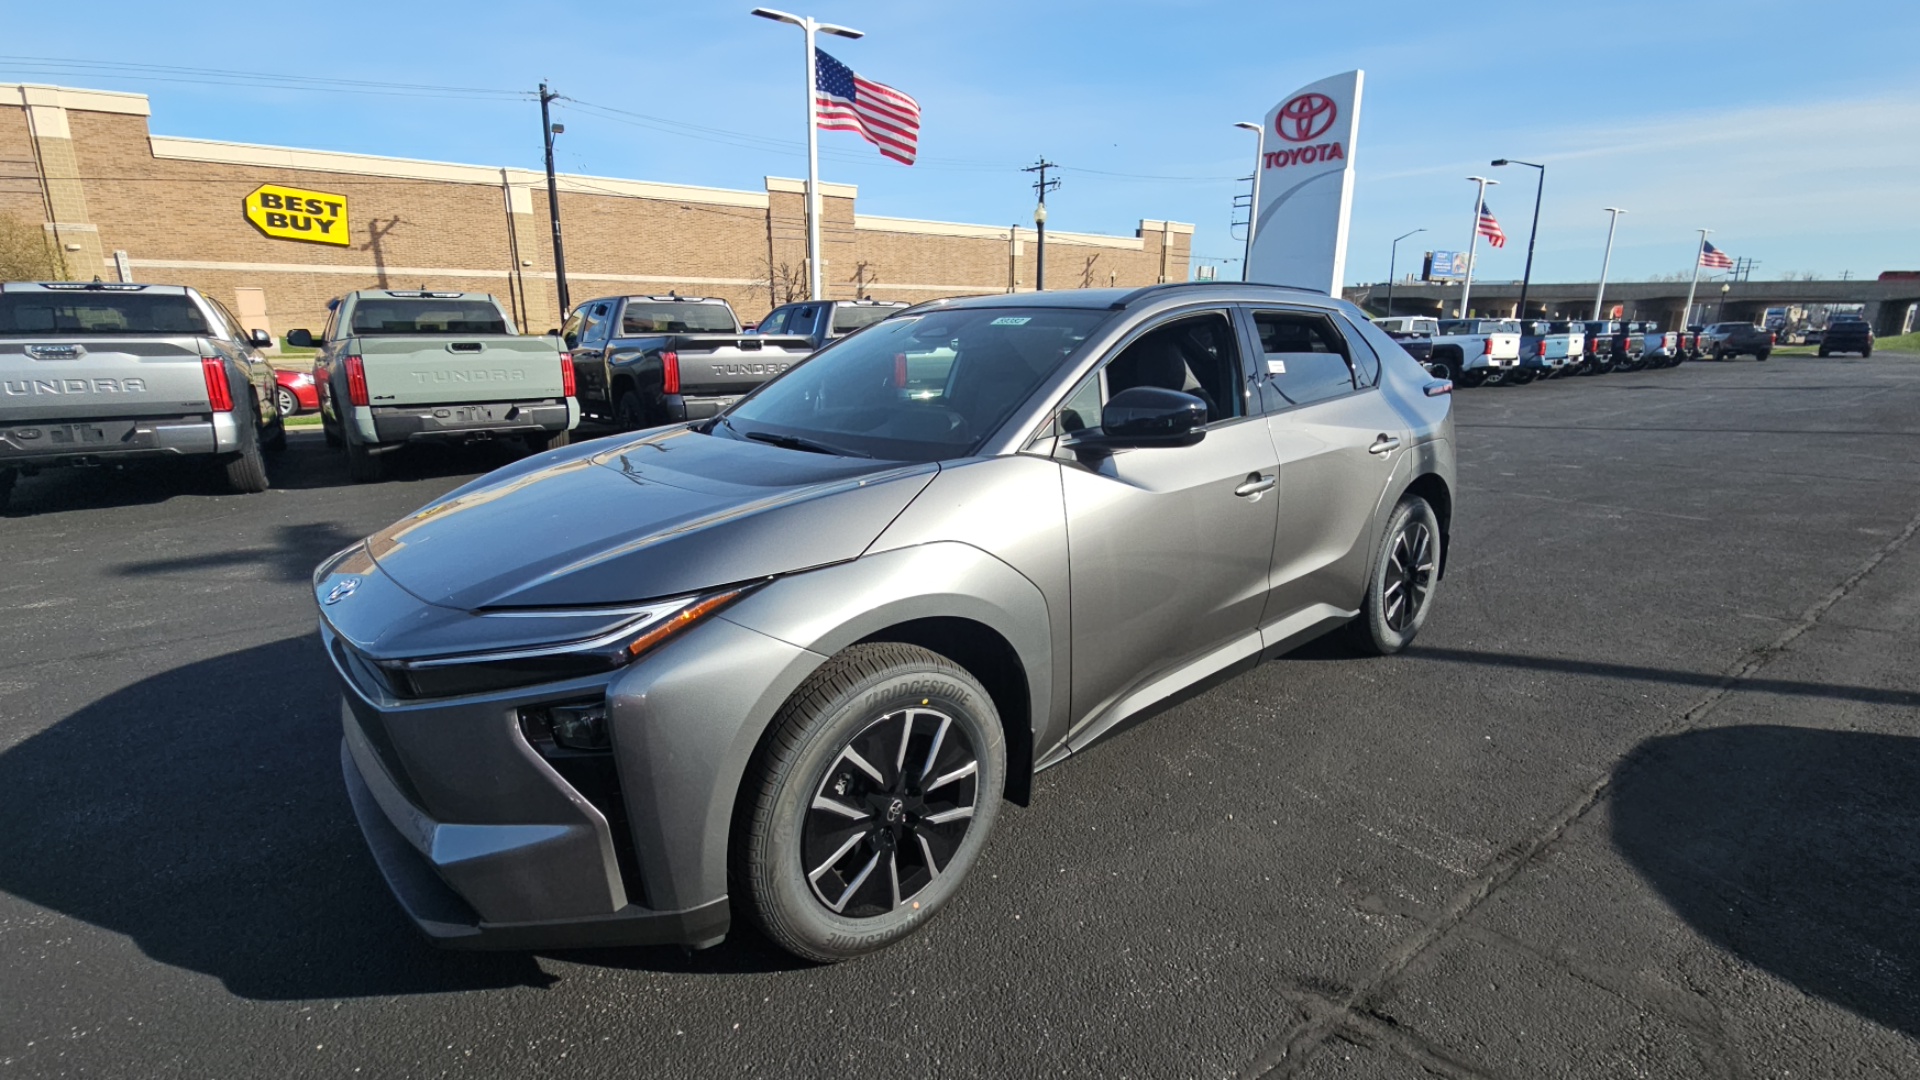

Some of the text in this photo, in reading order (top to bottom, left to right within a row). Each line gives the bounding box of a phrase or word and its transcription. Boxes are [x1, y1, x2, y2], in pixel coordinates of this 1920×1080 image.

[1263, 142, 1344, 169] TOYOTA
[260, 192, 342, 217] BEST
[266, 212, 336, 234] BUY
[411, 369, 525, 383] TUNDRA
[711, 363, 791, 375] TUNDRA
[864, 680, 972, 707] BRIDGESTONE
